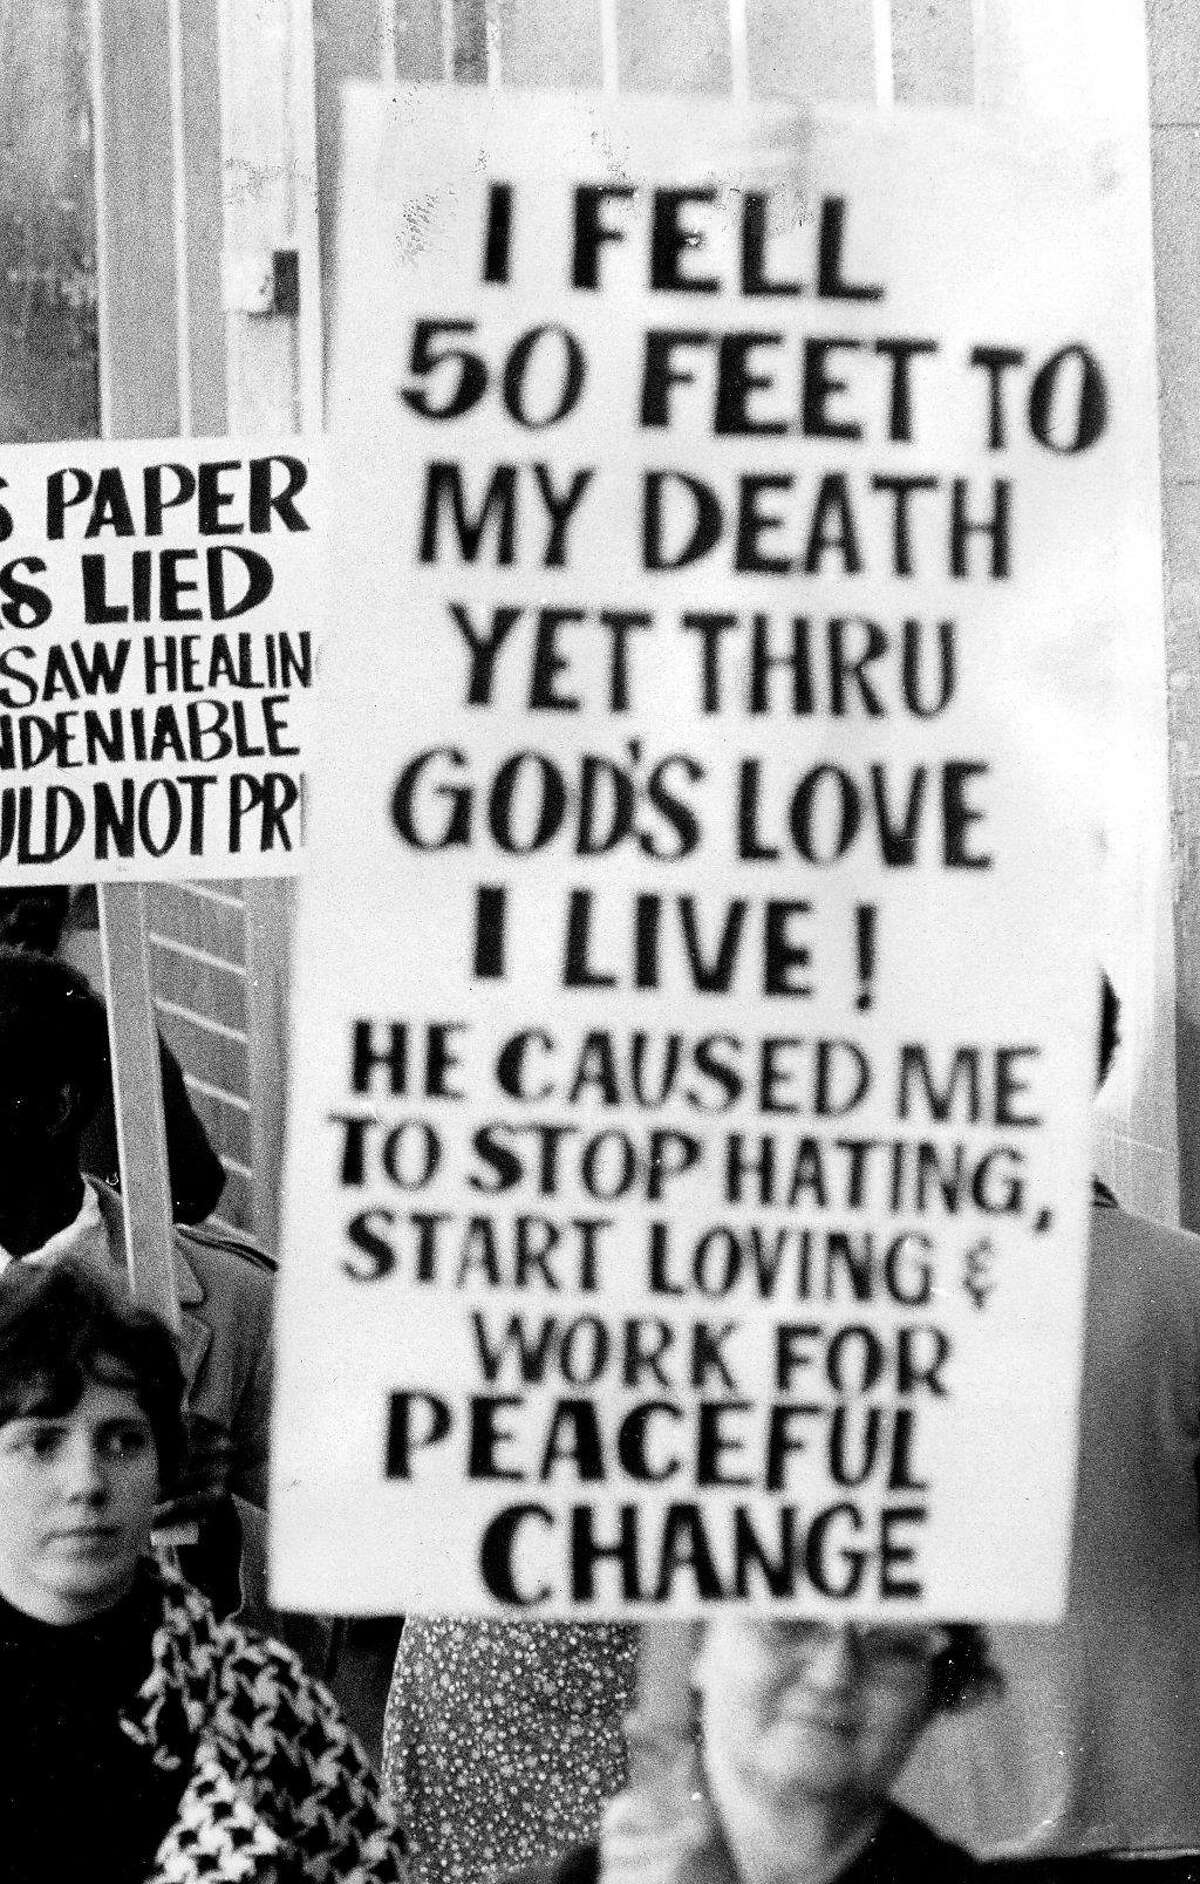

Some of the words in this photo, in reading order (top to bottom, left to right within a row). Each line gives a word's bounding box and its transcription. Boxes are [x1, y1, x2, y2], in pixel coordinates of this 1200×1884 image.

[481, 181, 514, 284] I
[570, 183, 885, 301] FELL
[400, 318, 587, 430] 50
[638, 327, 938, 444] FEET
[970, 341, 1111, 455] TO
[46, 455, 311, 540] PAPER
[417, 460, 596, 569] MY
[640, 469, 1013, 580] DEATH
[81, 546, 274, 625] LIED
[143, 631, 313, 695] HEALIN
[446, 603, 654, 712] YET
[681, 610, 960, 720] THRU
[94, 775, 218, 860] NOT
[229, 772, 308, 853] PR
[390, 739, 707, 863] GOD'S
[736, 756, 993, 870] LOVE
[472, 884, 508, 981] I
[350, 1019, 467, 1100] HE
[495, 1025, 873, 1115] CAUSED
[896, 1042, 1045, 1130] ME
[328, 1111, 444, 1191] TO
[467, 1116, 702, 1202] STOP
[724, 1130, 1055, 1234] HATING,
[341, 1206, 614, 1294] START
[647, 1219, 937, 1309] LOVING
[963, 1234, 997, 1312] &
[471, 1309, 740, 1390] WORK
[774, 1320, 954, 1399] FOR
[384, 1389, 929, 1493] PEACEFUL
[478, 1502, 929, 1604] CHANGE
